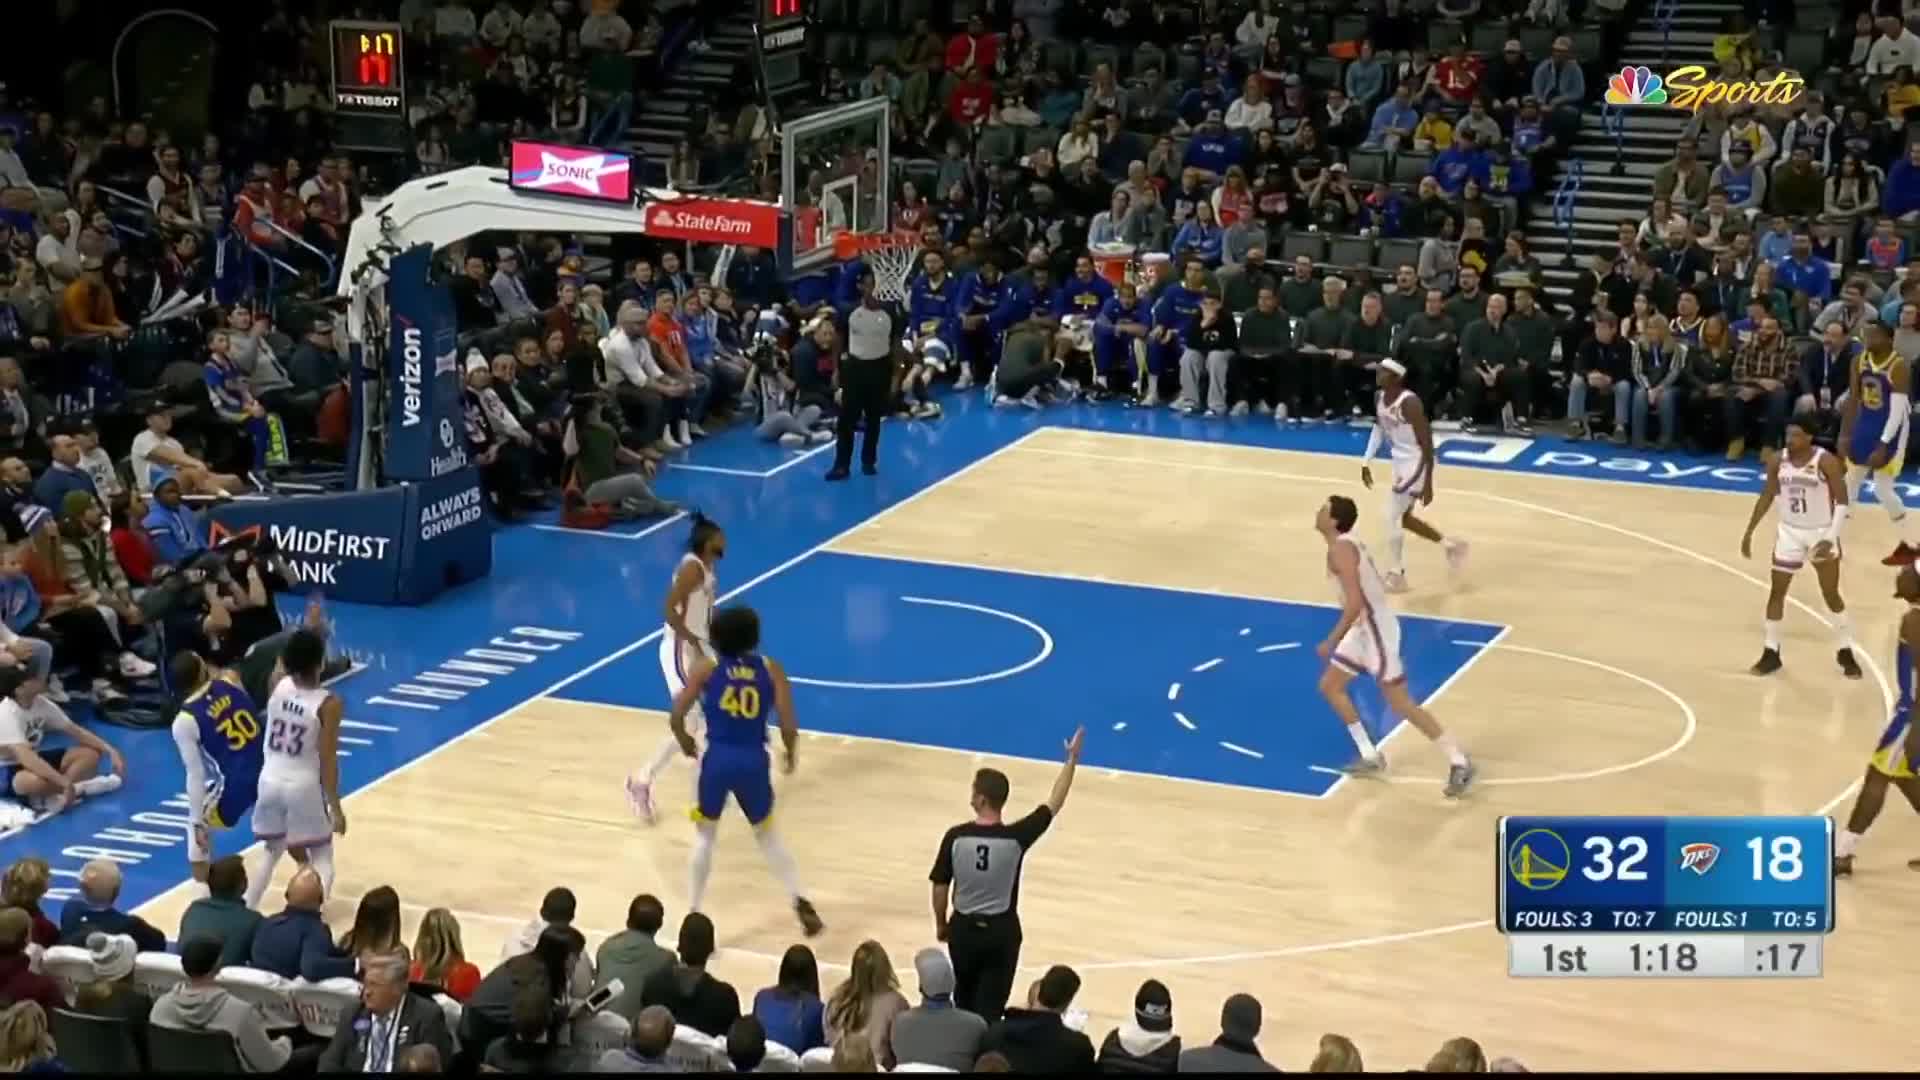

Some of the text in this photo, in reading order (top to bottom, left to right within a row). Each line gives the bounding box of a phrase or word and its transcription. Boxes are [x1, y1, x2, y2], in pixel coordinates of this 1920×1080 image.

[547, 163, 595, 180] SONIC
[400, 328, 421, 427] verizon
[431, 446, 467, 477] Health
[420, 487, 481, 524] ALWAYS
[421, 505, 482, 540] ONWARD
[268, 558, 338, 585] ANK
[365, 626, 584, 710] THUNDER
[720, 684, 760, 719] 40
[216, 708, 258, 751] 30
[270, 718, 306, 757] 23
[976, 844, 989, 871] 3
